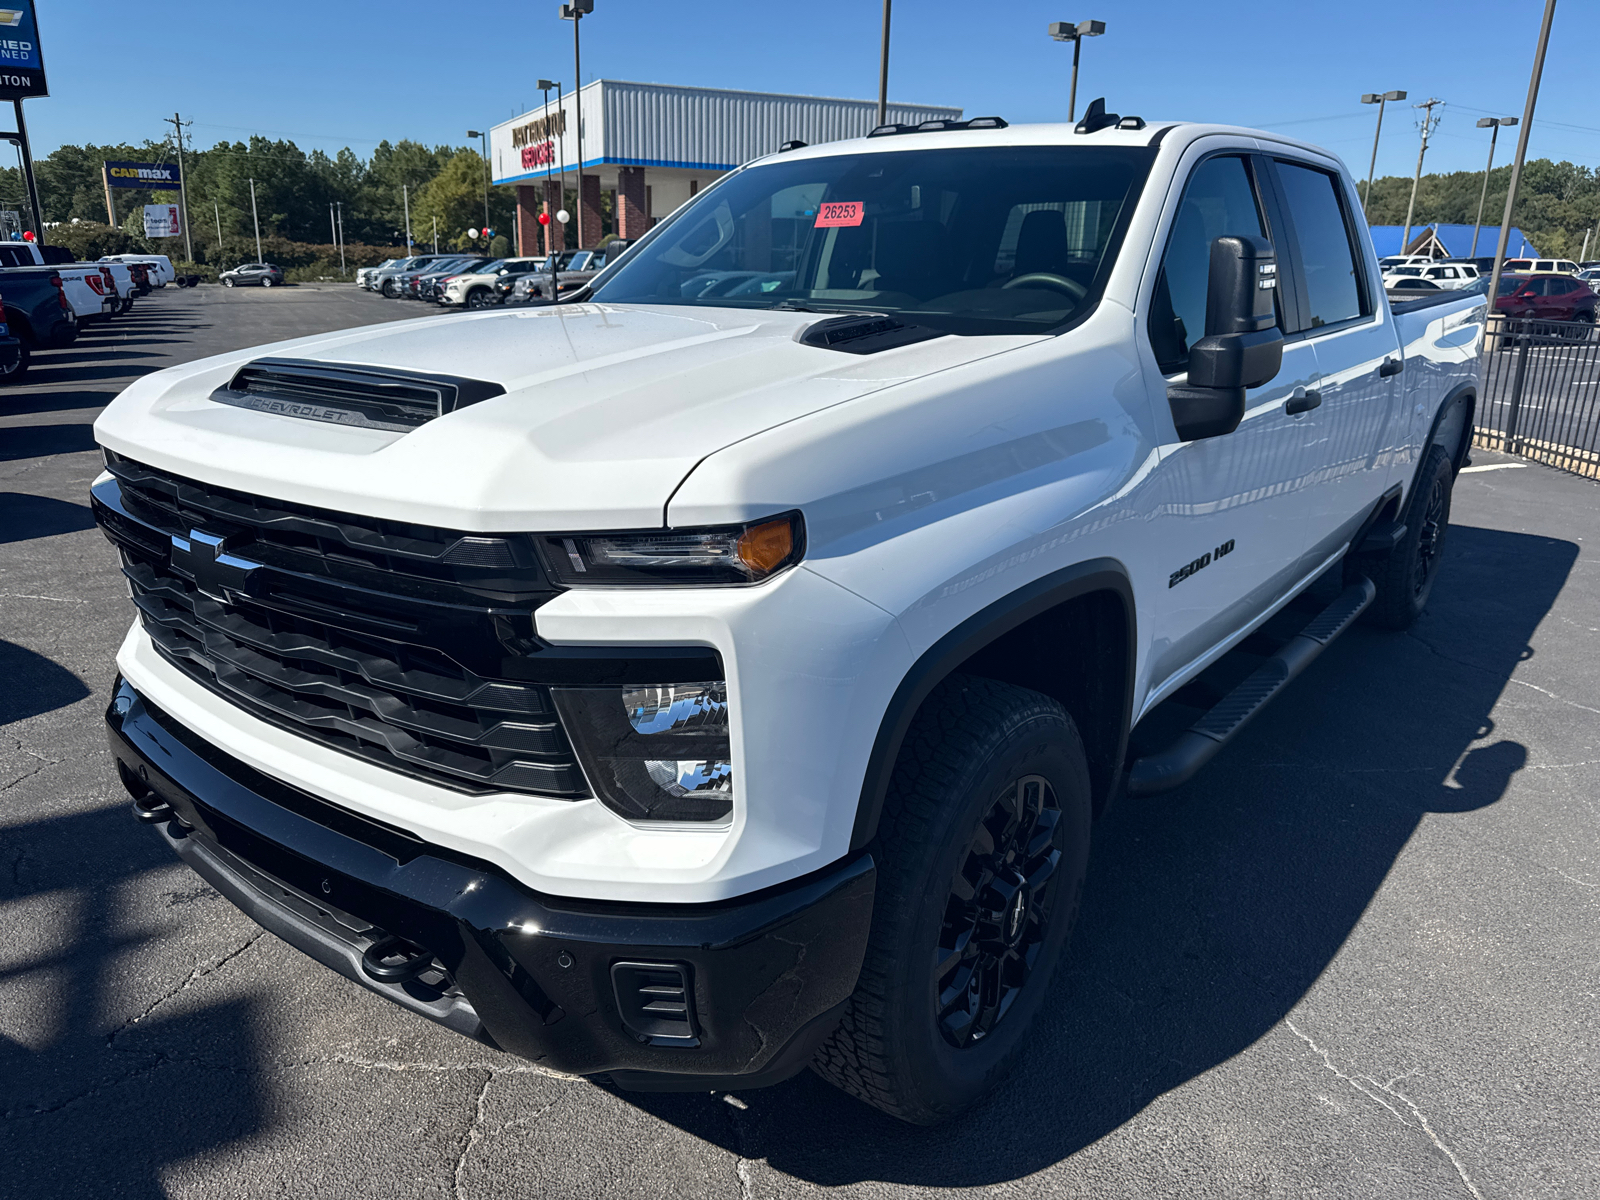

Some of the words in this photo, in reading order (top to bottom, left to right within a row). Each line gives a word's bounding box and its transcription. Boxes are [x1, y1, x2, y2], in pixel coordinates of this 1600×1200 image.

[0, 39, 32, 51] IED
[0, 75, 31, 87] TON
[824, 204, 856, 219] 26253
[250, 399, 348, 421] CHEVROLET
[1168, 552, 1212, 589] 2500
[1213, 538, 1236, 561] HD
